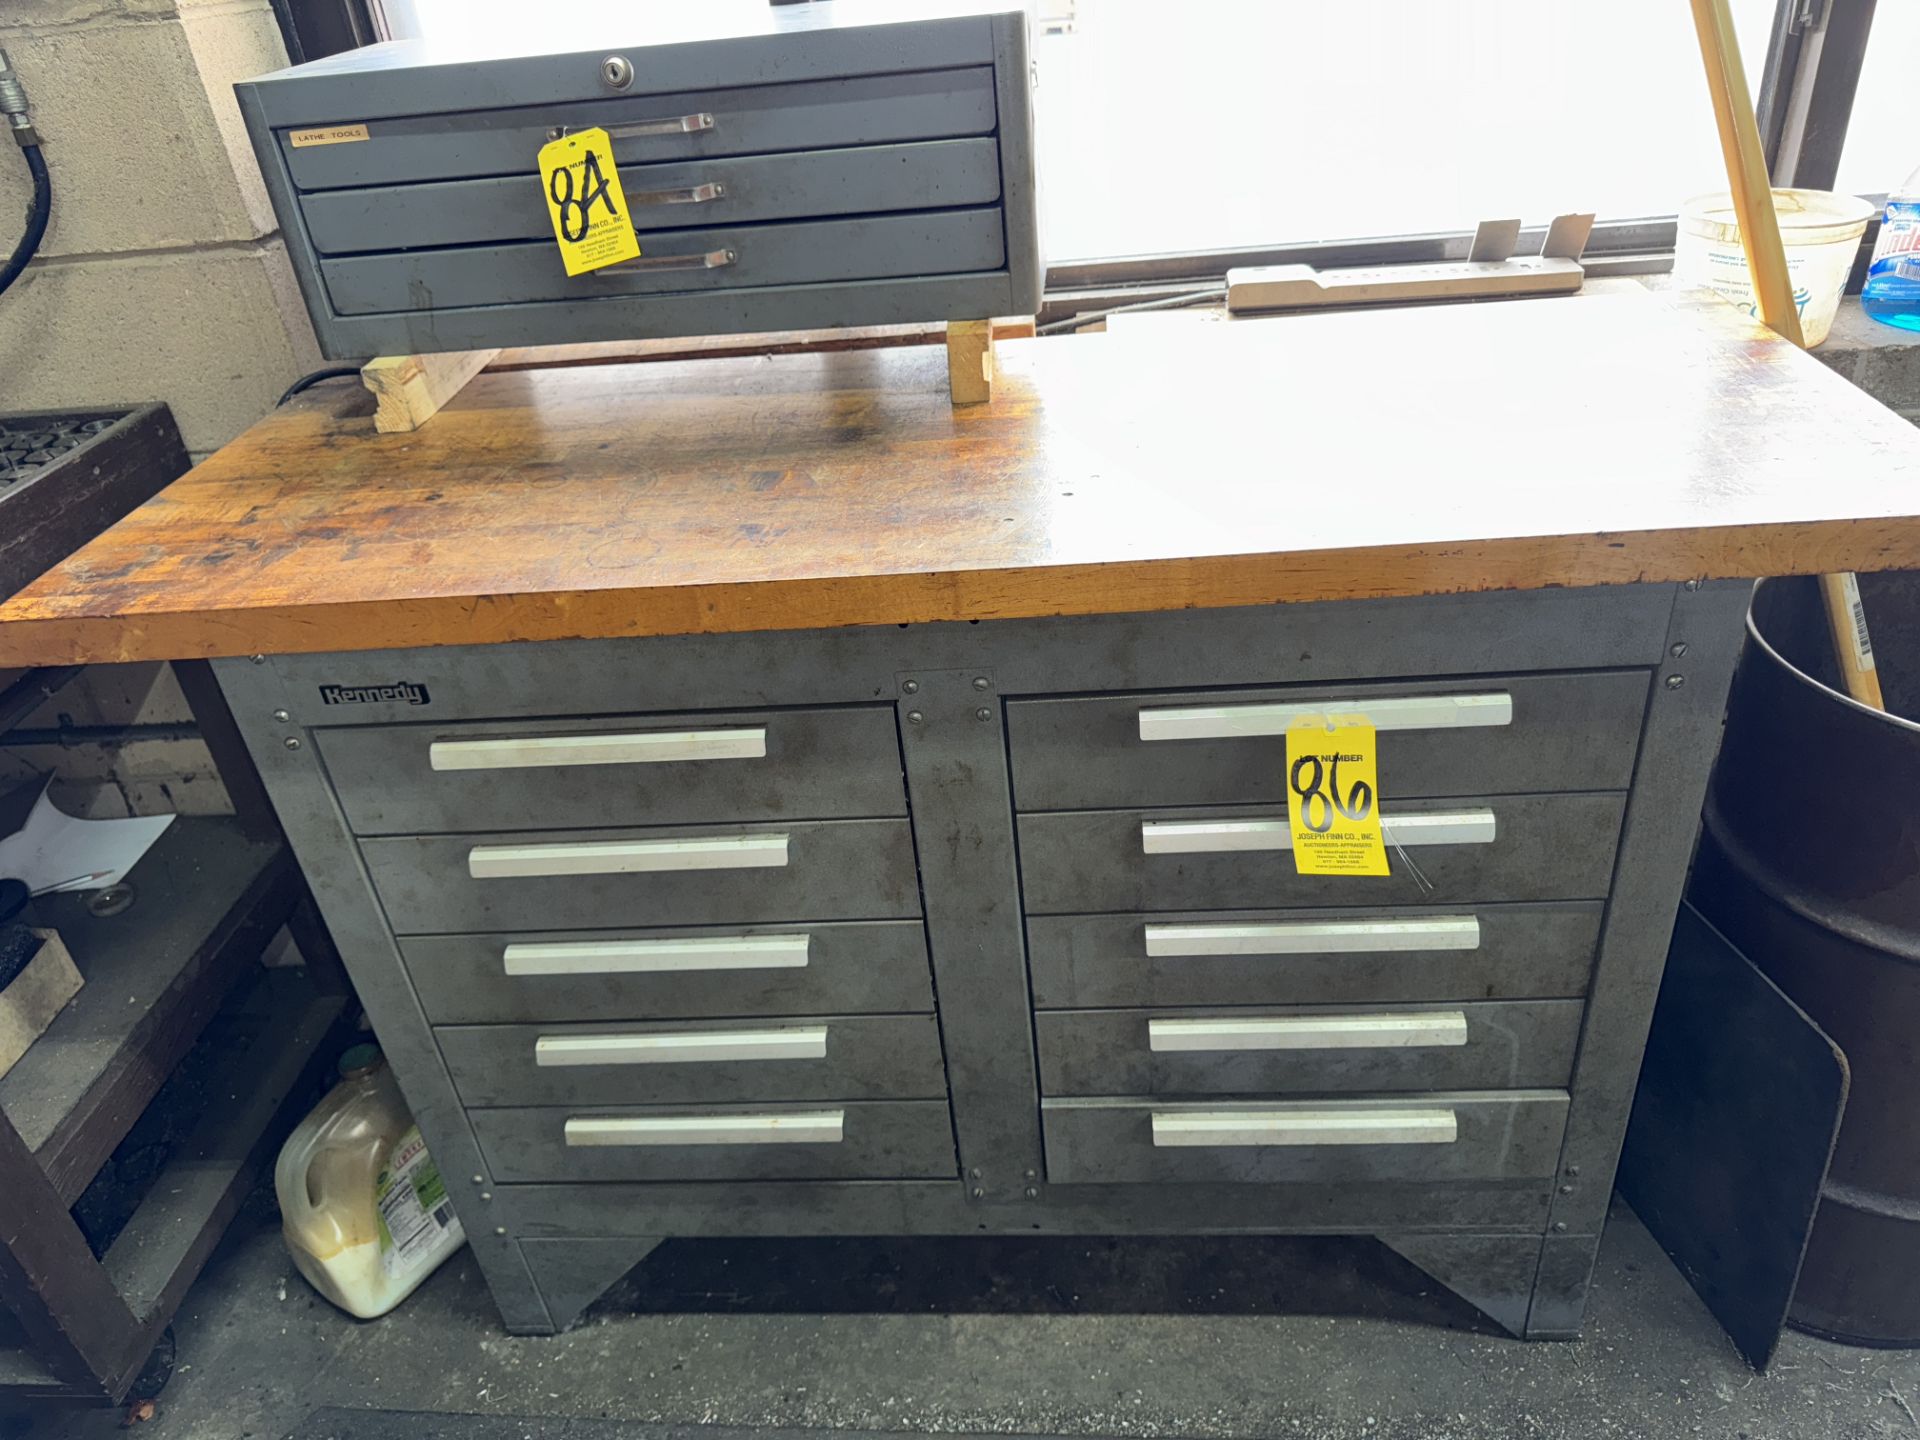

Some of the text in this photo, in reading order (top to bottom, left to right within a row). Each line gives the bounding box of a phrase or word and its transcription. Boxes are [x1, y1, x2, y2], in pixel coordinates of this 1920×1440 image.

[299, 130, 361, 142] LATHE TOOLS
[550, 150, 617, 243] 8A
[324, 683, 423, 706] Kennedy
[1291, 751, 1372, 833] 86
[1296, 832, 1325, 841] JOSEPH
[1326, 832, 1344, 841] FINN
